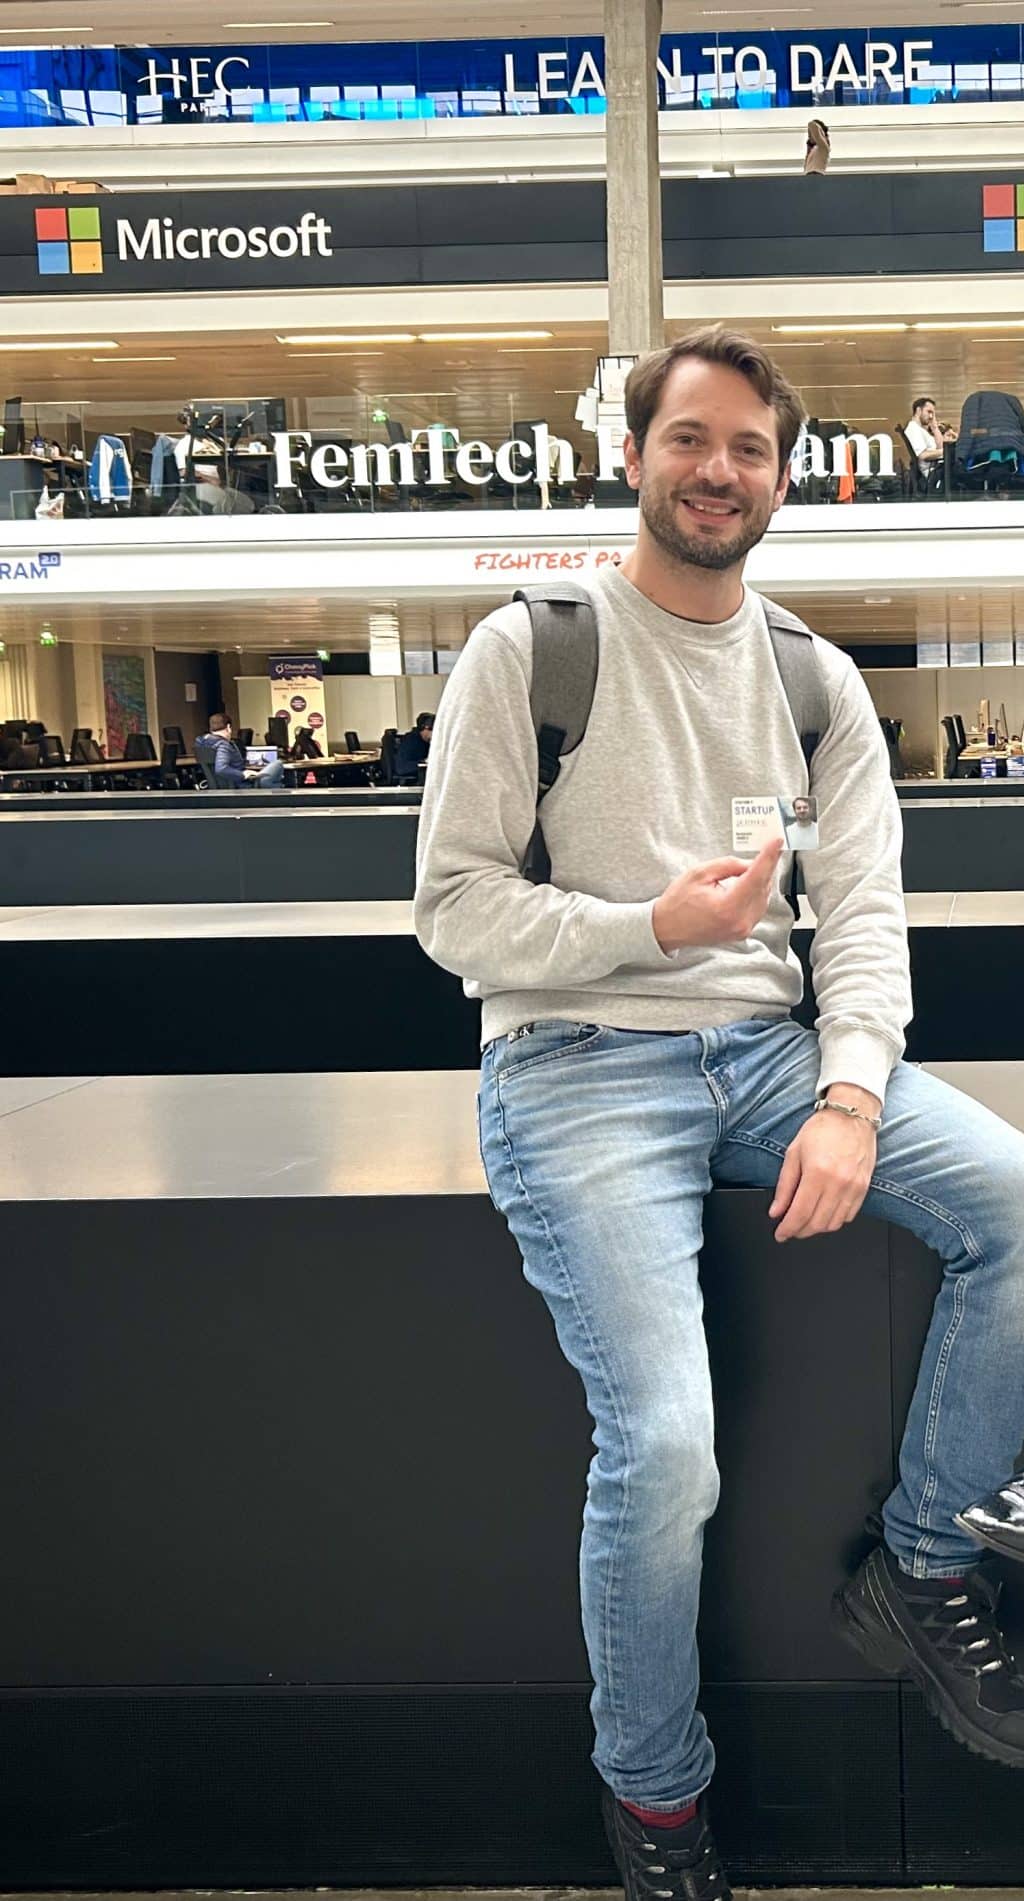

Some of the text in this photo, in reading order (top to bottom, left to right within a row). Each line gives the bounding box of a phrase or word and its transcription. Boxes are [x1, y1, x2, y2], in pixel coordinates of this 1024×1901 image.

[137, 56, 250, 99] HEC
[505, 40, 933, 98] LEAN TO DARE
[116, 212, 333, 261] Microsoft
[271, 423, 578, 488] FemTech
[474, 552, 587, 570] FIGHTERS
[734, 806, 774, 815] STARTUP
